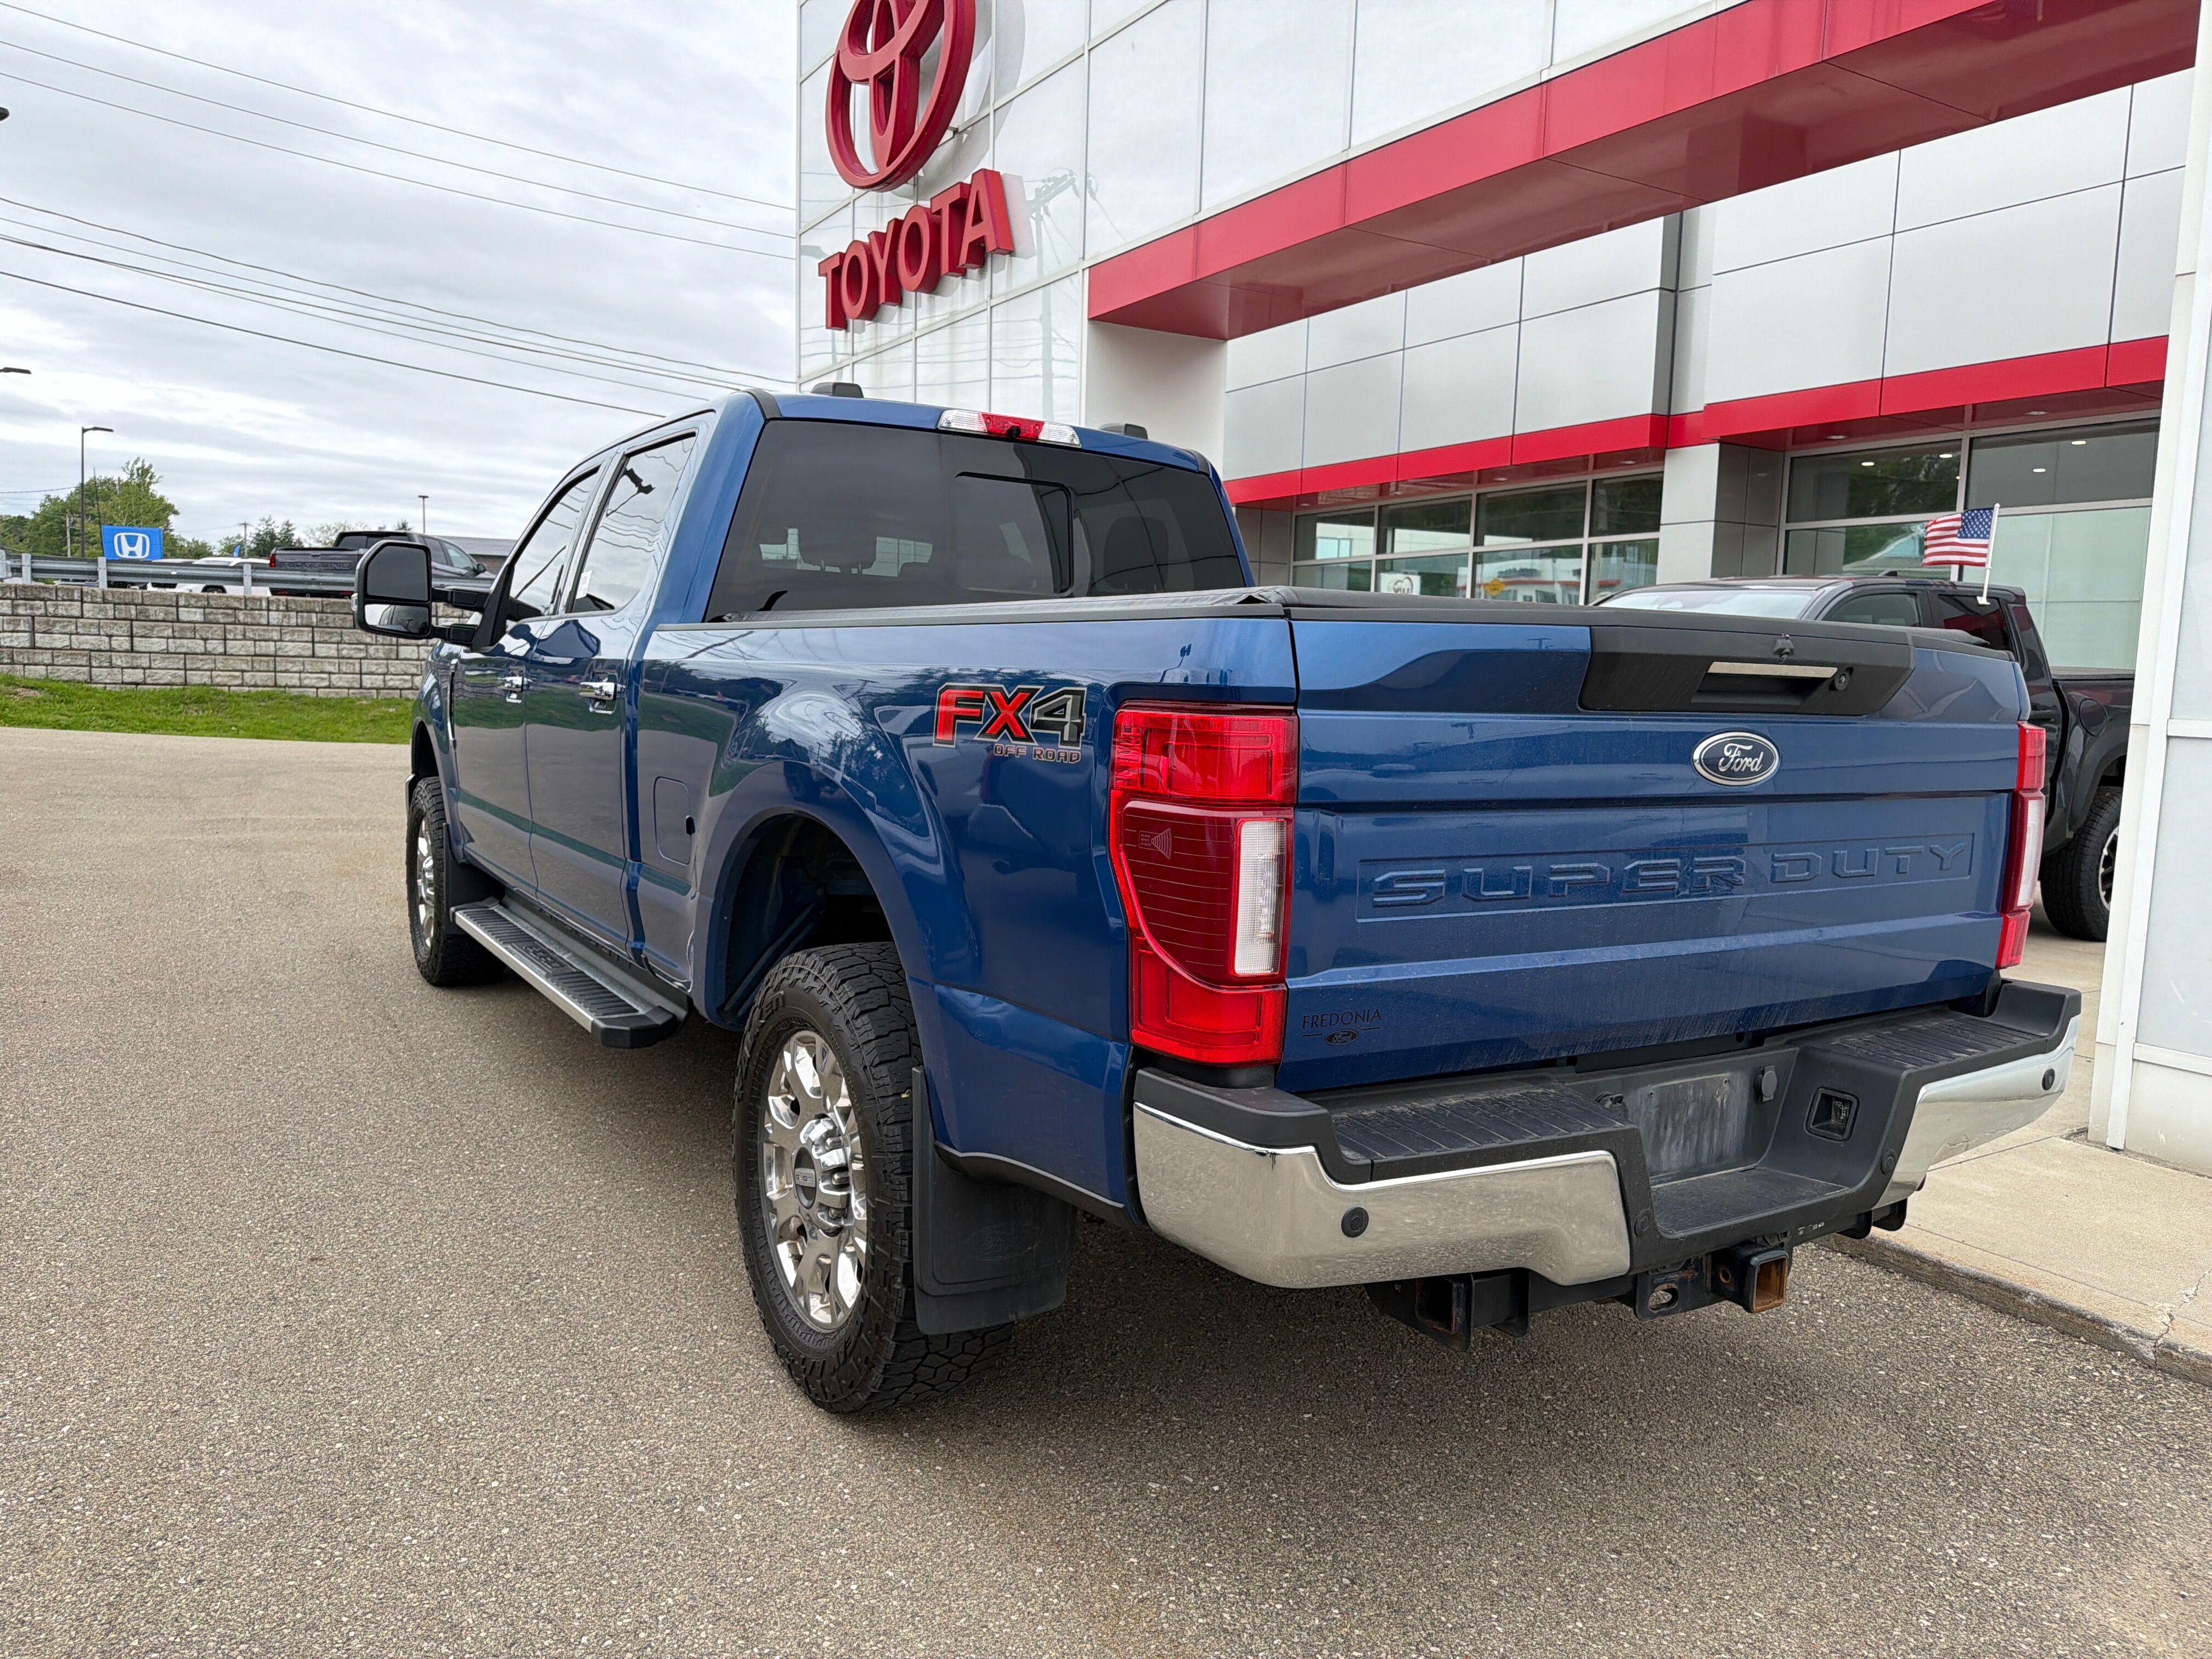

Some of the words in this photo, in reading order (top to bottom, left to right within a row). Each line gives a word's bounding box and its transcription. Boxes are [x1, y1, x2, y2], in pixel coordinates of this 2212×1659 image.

[818, 168, 1014, 331] TOYOTA
[933, 682, 1087, 749] FX4
[994, 743, 1026, 758] OFF
[1032, 747, 1081, 764] ROAD
[1718, 743, 1764, 772] Ford
[1373, 856, 1747, 907] SUPER
[1770, 842, 1966, 883] DUTY
[1302, 1009, 1381, 1029] FREDONIA
